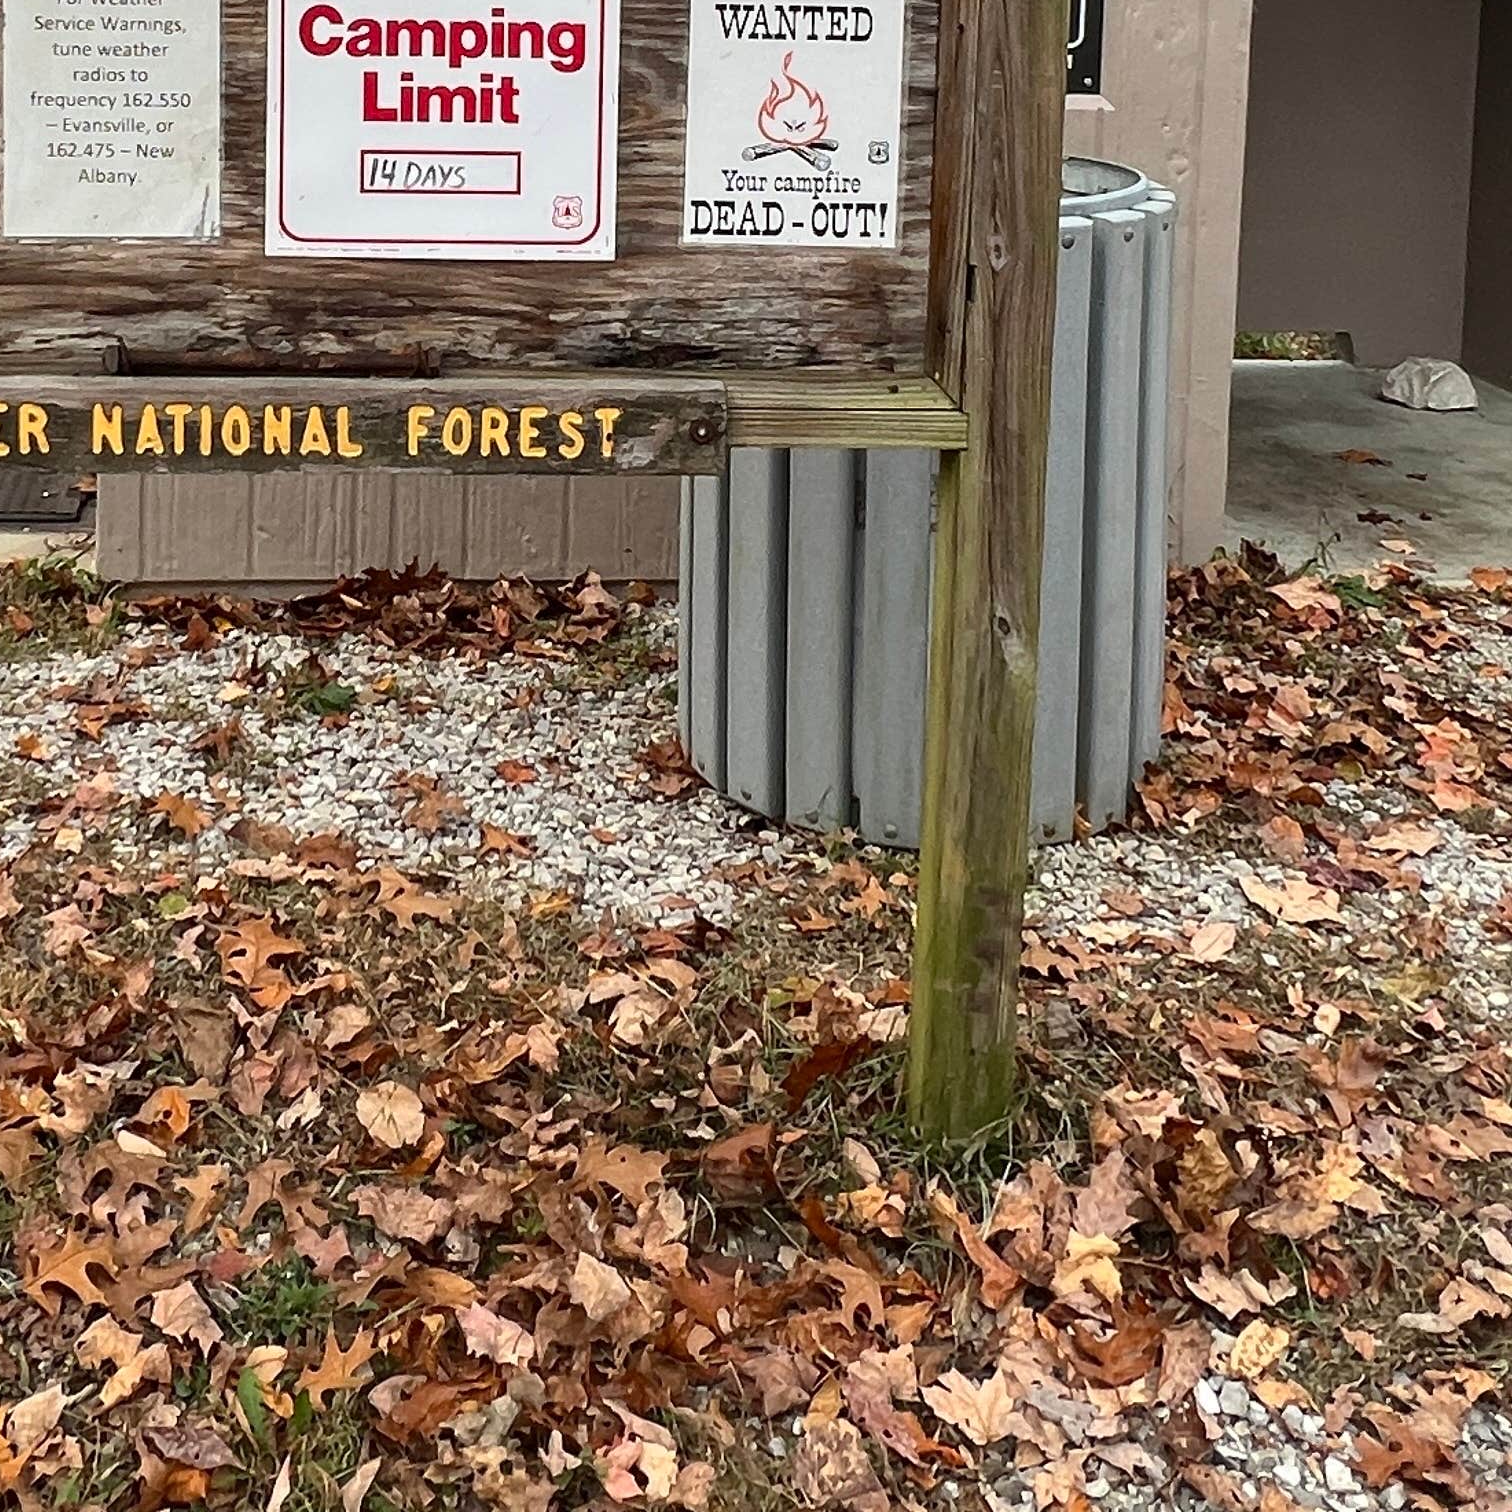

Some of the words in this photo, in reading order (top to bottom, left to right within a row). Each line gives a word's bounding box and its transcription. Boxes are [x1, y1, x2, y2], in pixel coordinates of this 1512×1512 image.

[34, 16, 96, 31] Service
[100, 16, 187, 34] Warnings,
[716, 4, 873, 41] WANTED
[52, 43, 92, 56] tune
[98, 42, 169, 57] weather
[299, 4, 586, 72] Camping
[73, 68, 125, 82] radios
[130, 69, 148, 82] to
[30, 92, 116, 110] frequency
[123, 93, 191, 108] 162.550
[363, 71, 519, 124] Limit
[62, 118, 152, 135] Evansville,
[156, 121, 175, 132] or
[47, 143, 115, 158] 162.475
[136, 144, 175, 158] New
[369, 158, 398, 187] 14
[404, 161, 466, 189] DAYS
[721, 170, 768, 192] Your
[774, 170, 861, 200] campfire
[91, 401, 364, 458] NATIONAL
[407, 405, 624, 459] FOREST
